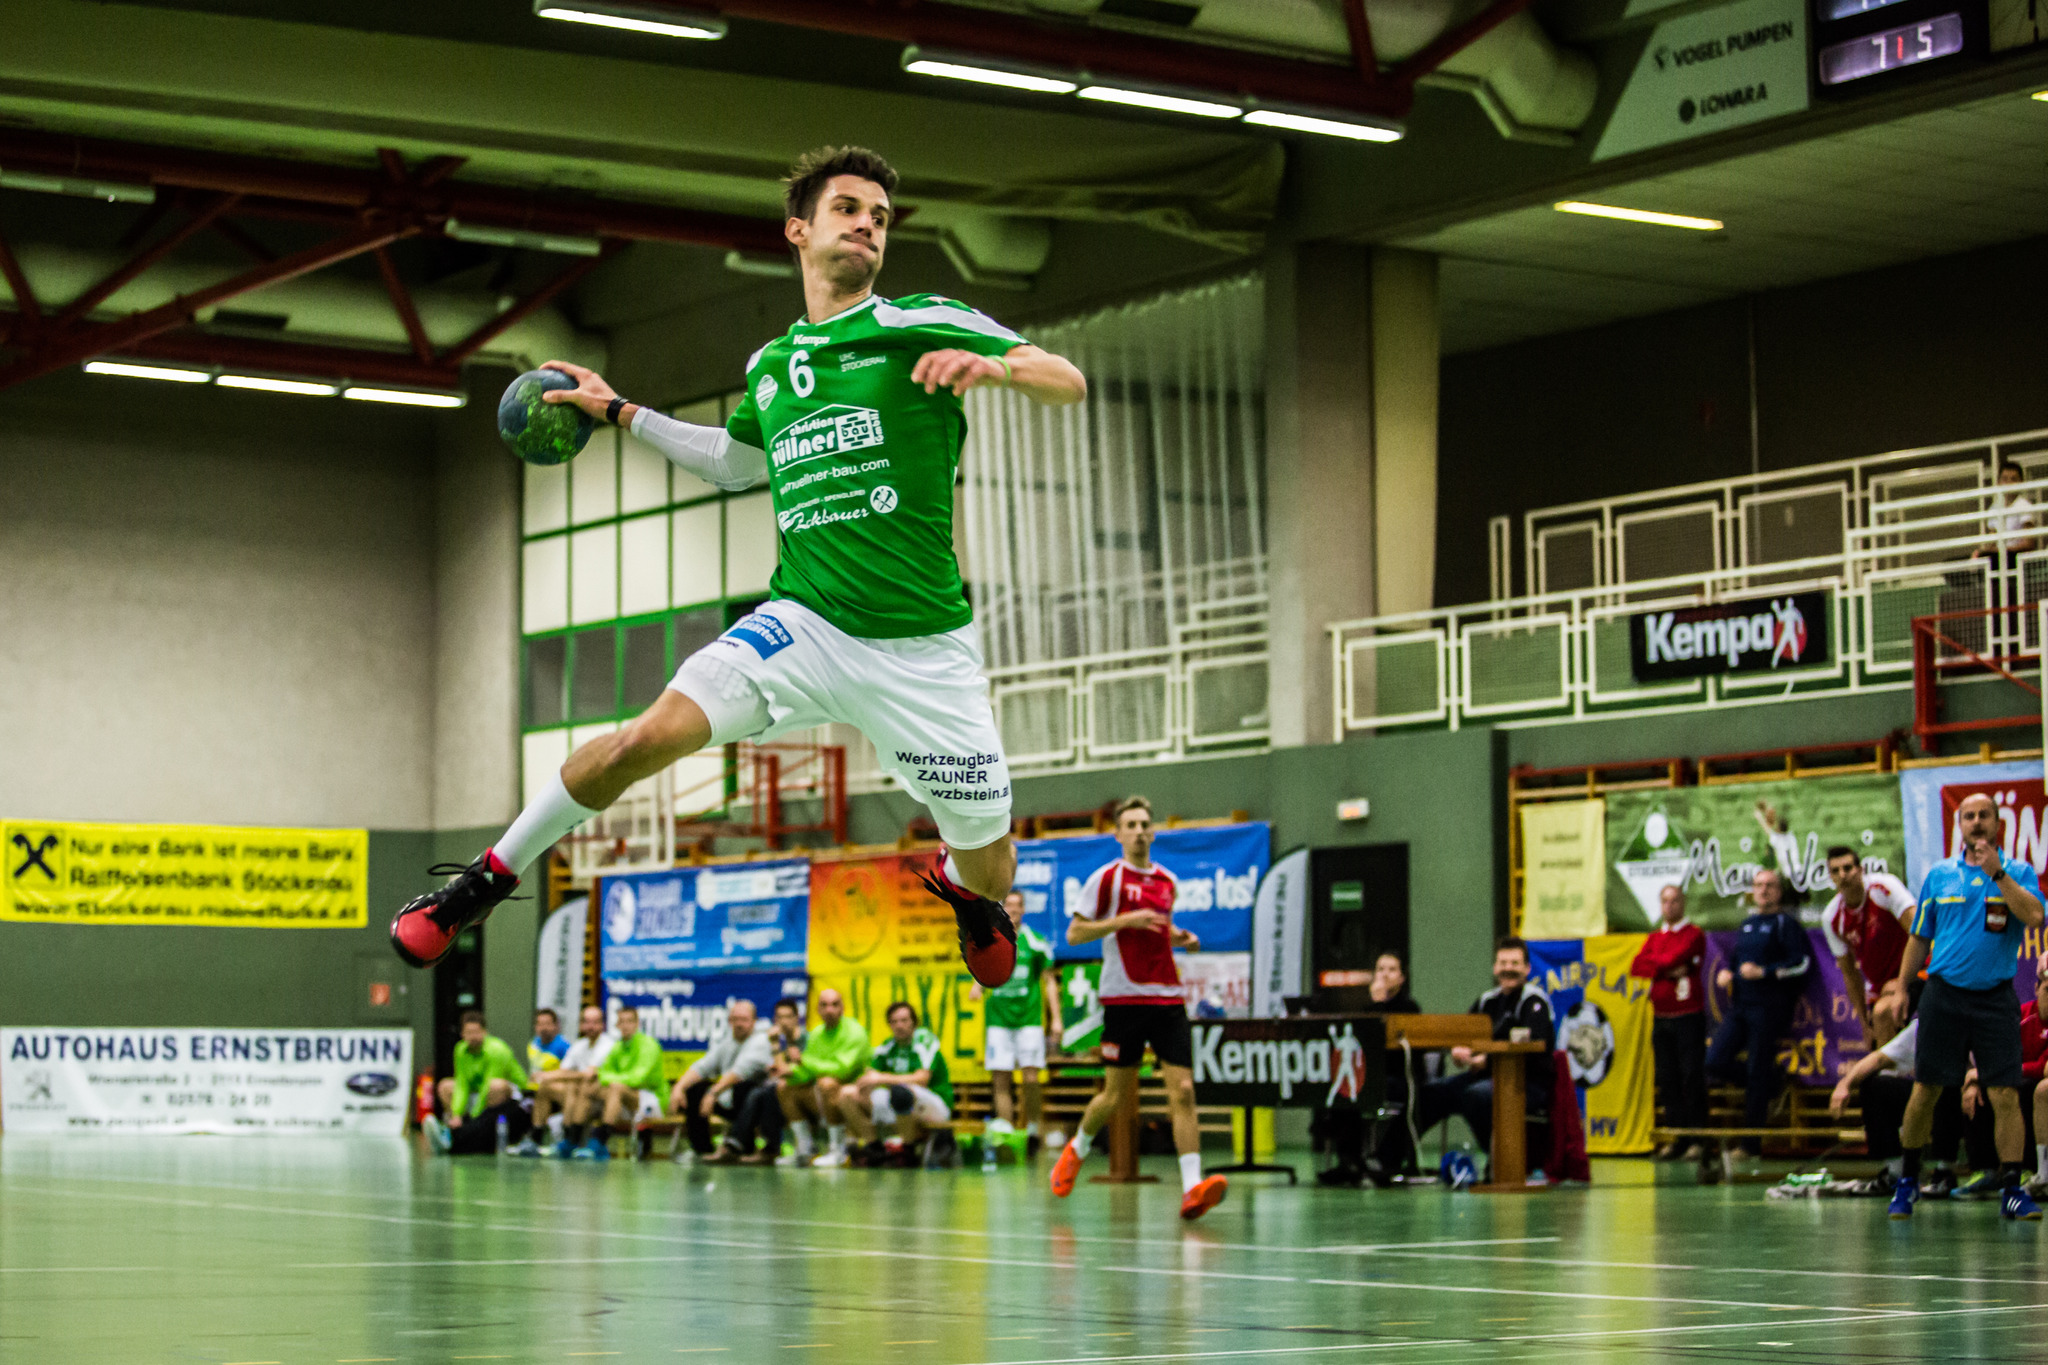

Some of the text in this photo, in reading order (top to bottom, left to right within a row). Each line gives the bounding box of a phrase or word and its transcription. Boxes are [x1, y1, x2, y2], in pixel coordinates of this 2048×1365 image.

[1673, 20, 1794, 67] VOGEL PUMPEN
[793, 334, 830, 346] Kempa
[841, 355, 887, 372] STOCKERAU
[788, 349, 816, 399] 6
[789, 416, 835, 437] christian
[841, 425, 869, 438] bau
[1645, 611, 1775, 668] Kempa
[895, 750, 999, 769] Werkzeugbau
[917, 769, 988, 784] ZAUNER
[930, 786, 1009, 801] wzbstein.a
[159, 840, 205, 857] Bank
[11, 1035, 401, 1062] AUTOHAUS ERNSTBRUNN
[1190, 1024, 1332, 1101] Kempa
